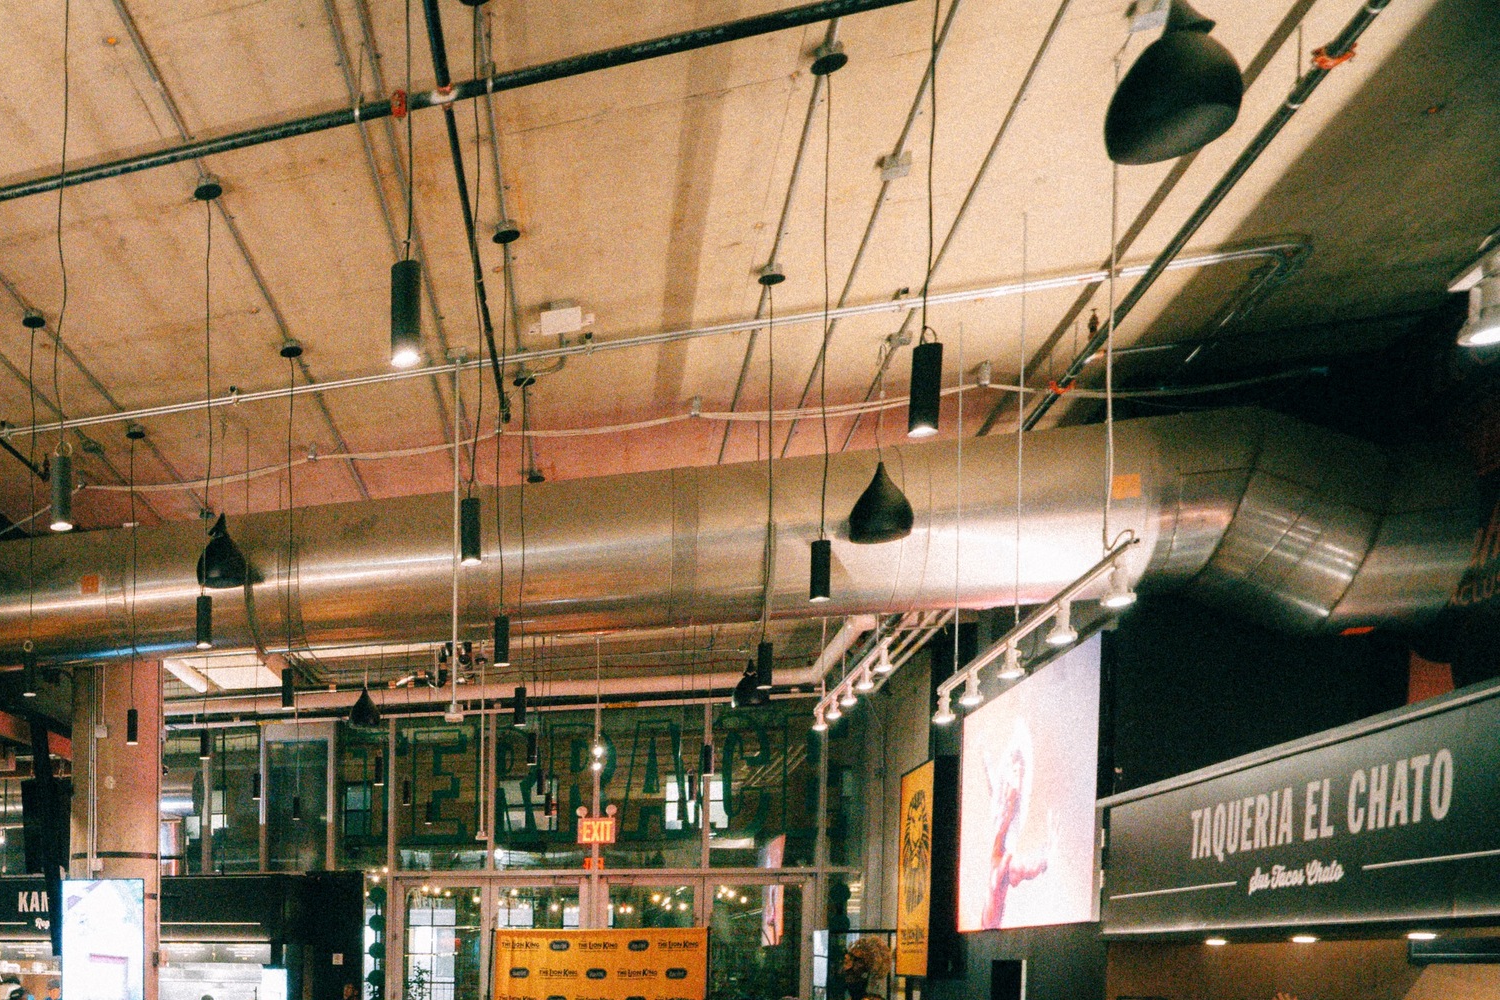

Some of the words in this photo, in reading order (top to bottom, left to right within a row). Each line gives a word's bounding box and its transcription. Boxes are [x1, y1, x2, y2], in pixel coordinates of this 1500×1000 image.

[1191, 787, 1293, 862] TAQUERIA
[1303, 778, 1334, 841] EL
[1347, 749, 1453, 834] CHATO
[582, 821, 613, 842] EXIT
[1270, 864, 1305, 889] Tacos
[1306, 859, 1344, 886] Chato
